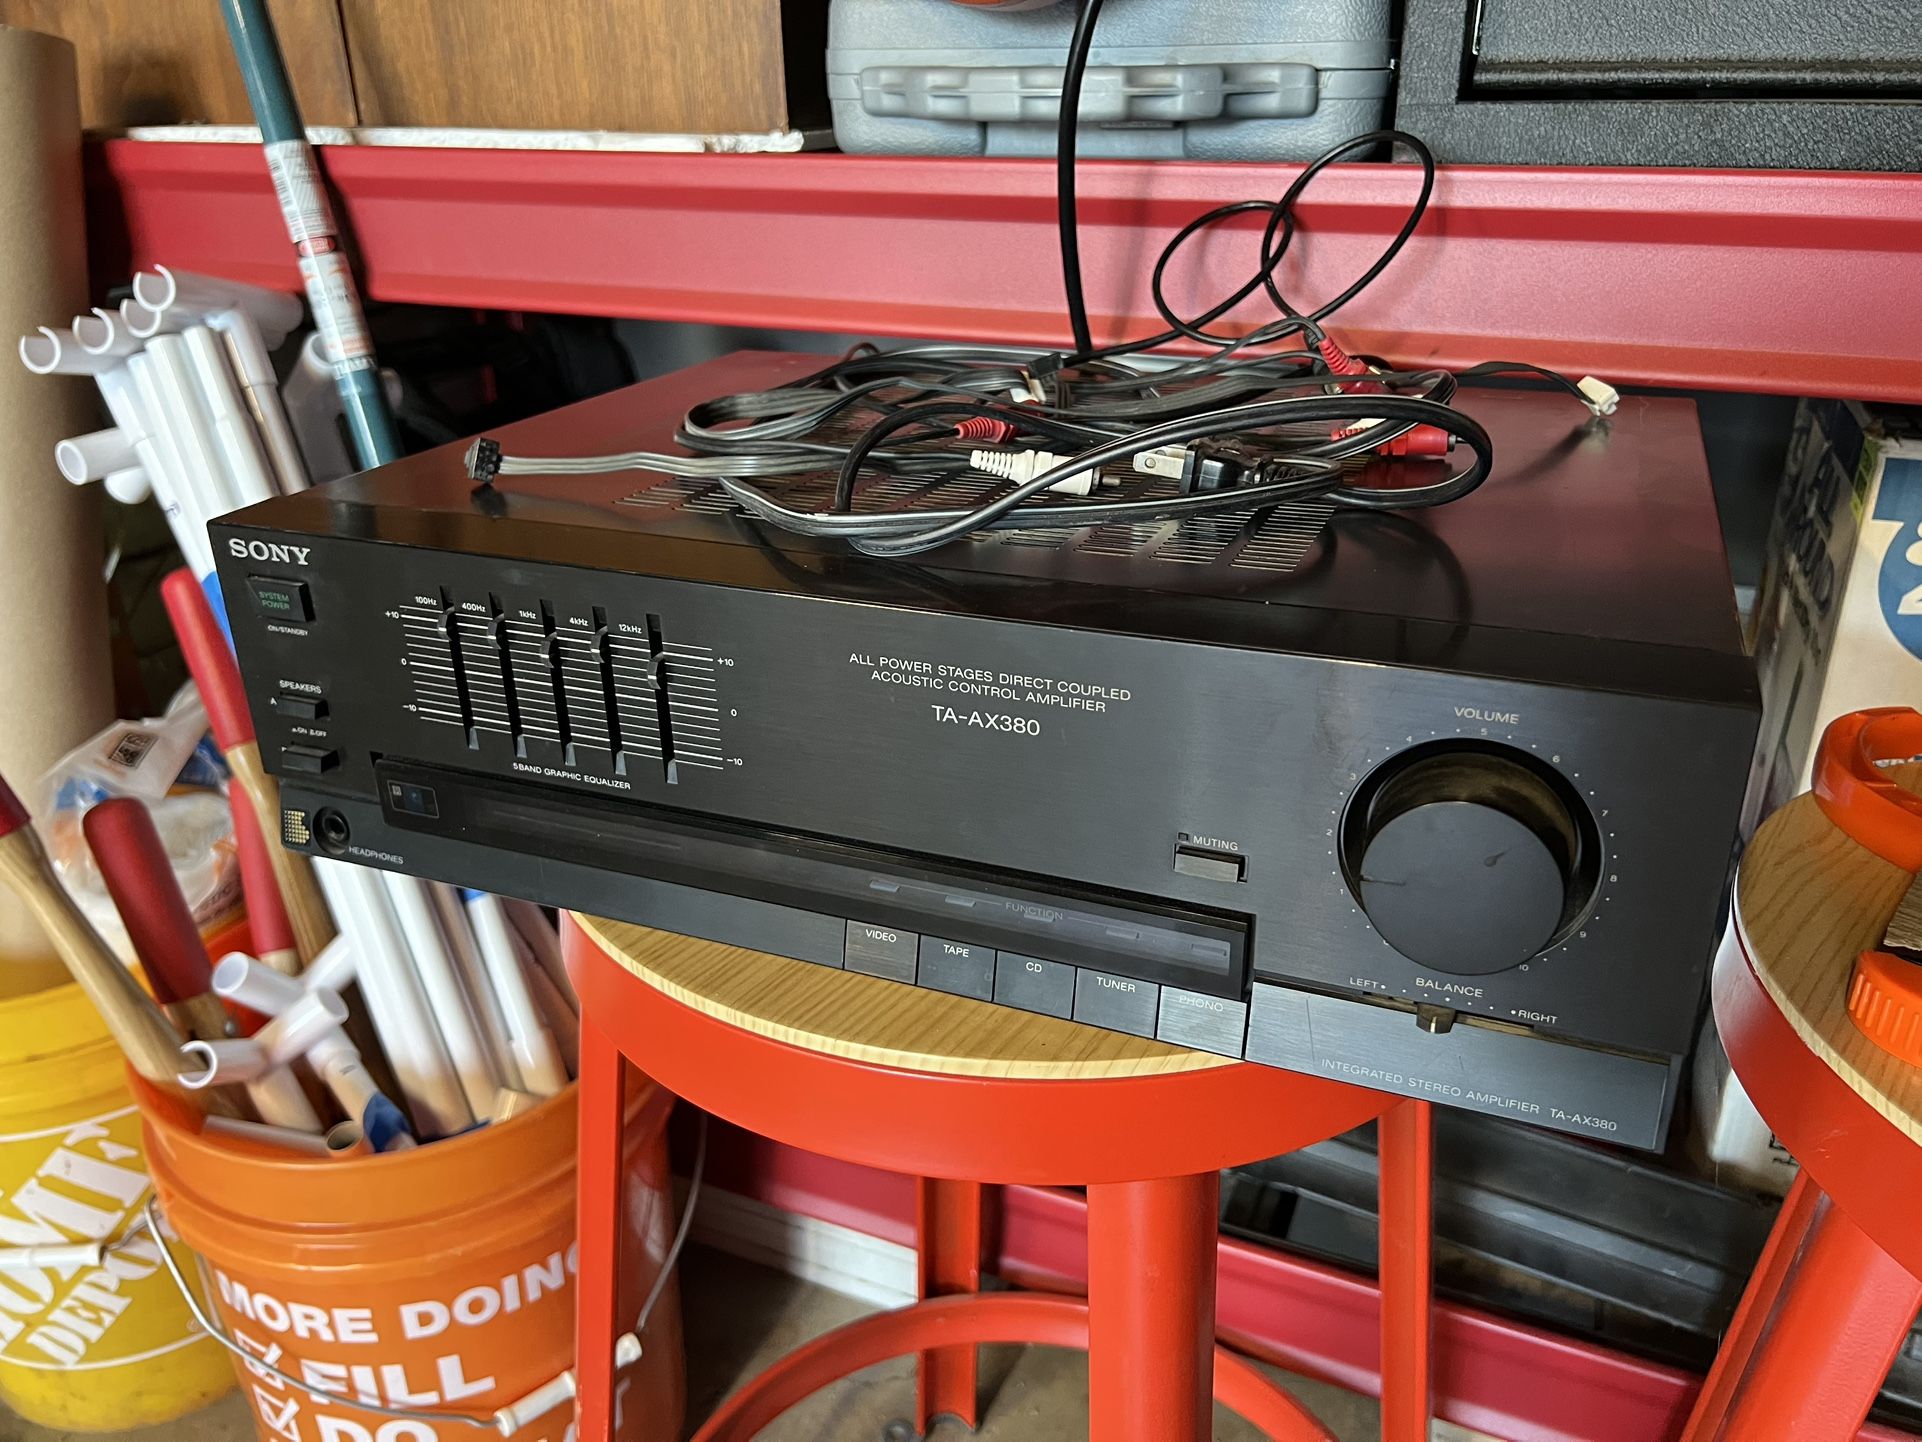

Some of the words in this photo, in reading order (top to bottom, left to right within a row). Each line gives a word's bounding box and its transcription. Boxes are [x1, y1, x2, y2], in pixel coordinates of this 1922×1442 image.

[228, 537, 311, 566] SONY
[258, 590, 290, 602] SYSTEM
[415, 595, 437, 606] 100Hz
[261, 599, 290, 611] POWER
[461, 602, 486, 613] 400Hz
[385, 610, 399, 620] +10
[518, 609, 536, 620] 1kHz
[569, 616, 589, 627] 4kHz
[267, 624, 309, 638] ON/STANDBY
[618, 623, 642, 635] 12kHz
[717, 656, 734, 667] +10
[849, 652, 875, 666] ALL
[879, 656, 933, 675] POWER
[937, 664, 994, 683] STAGES
[999, 673, 1053, 691] DIRECT
[1057, 681, 1131, 702] COUPLED
[279, 680, 322, 694] SPEAKERS
[871, 670, 944, 690] ACOUSTIC
[948, 681, 1021, 701] CONTROL
[1025, 691, 1106, 713] AMPLIFIER
[931, 704, 1041, 736] TA-AX380
[1454, 706, 1520, 725] VOLUME
[1406, 735, 1413, 743] 4
[1552, 755, 1560, 763] 6
[543, 768, 582, 782] GRAPHIC
[583, 774, 631, 790] EQUALIZER
[1350, 772, 1356, 781] 3
[1326, 828, 1333, 837] 2
[1193, 835, 1239, 851] MUTING
[349, 845, 404, 865] HEADPHONES
[1609, 874, 1618, 883] 8
[1005, 902, 1064, 921] FUNCTION
[865, 928, 897, 944] VIDEO
[1579, 930, 1587, 939] 9
[943, 944, 970, 958] TAPE
[1025, 961, 1043, 974] CD
[1096, 976, 1136, 994] TUNER
[1349, 976, 1378, 989] LEFT
[1415, 977, 1484, 998] BALANCE
[1179, 994, 1224, 1013] PHONO
[1518, 1009, 1558, 1025] RIGHT
[1321, 1058, 1403, 1085] INTEGRATED
[1408, 1077, 1461, 1098] STEREO
[1466, 1090, 1540, 1115] AMPLIFIER
[1549, 1107, 1618, 1132] TA-AX380
[215, 1270, 379, 1344] MORE
[301, 1354, 496, 1409] FILL
